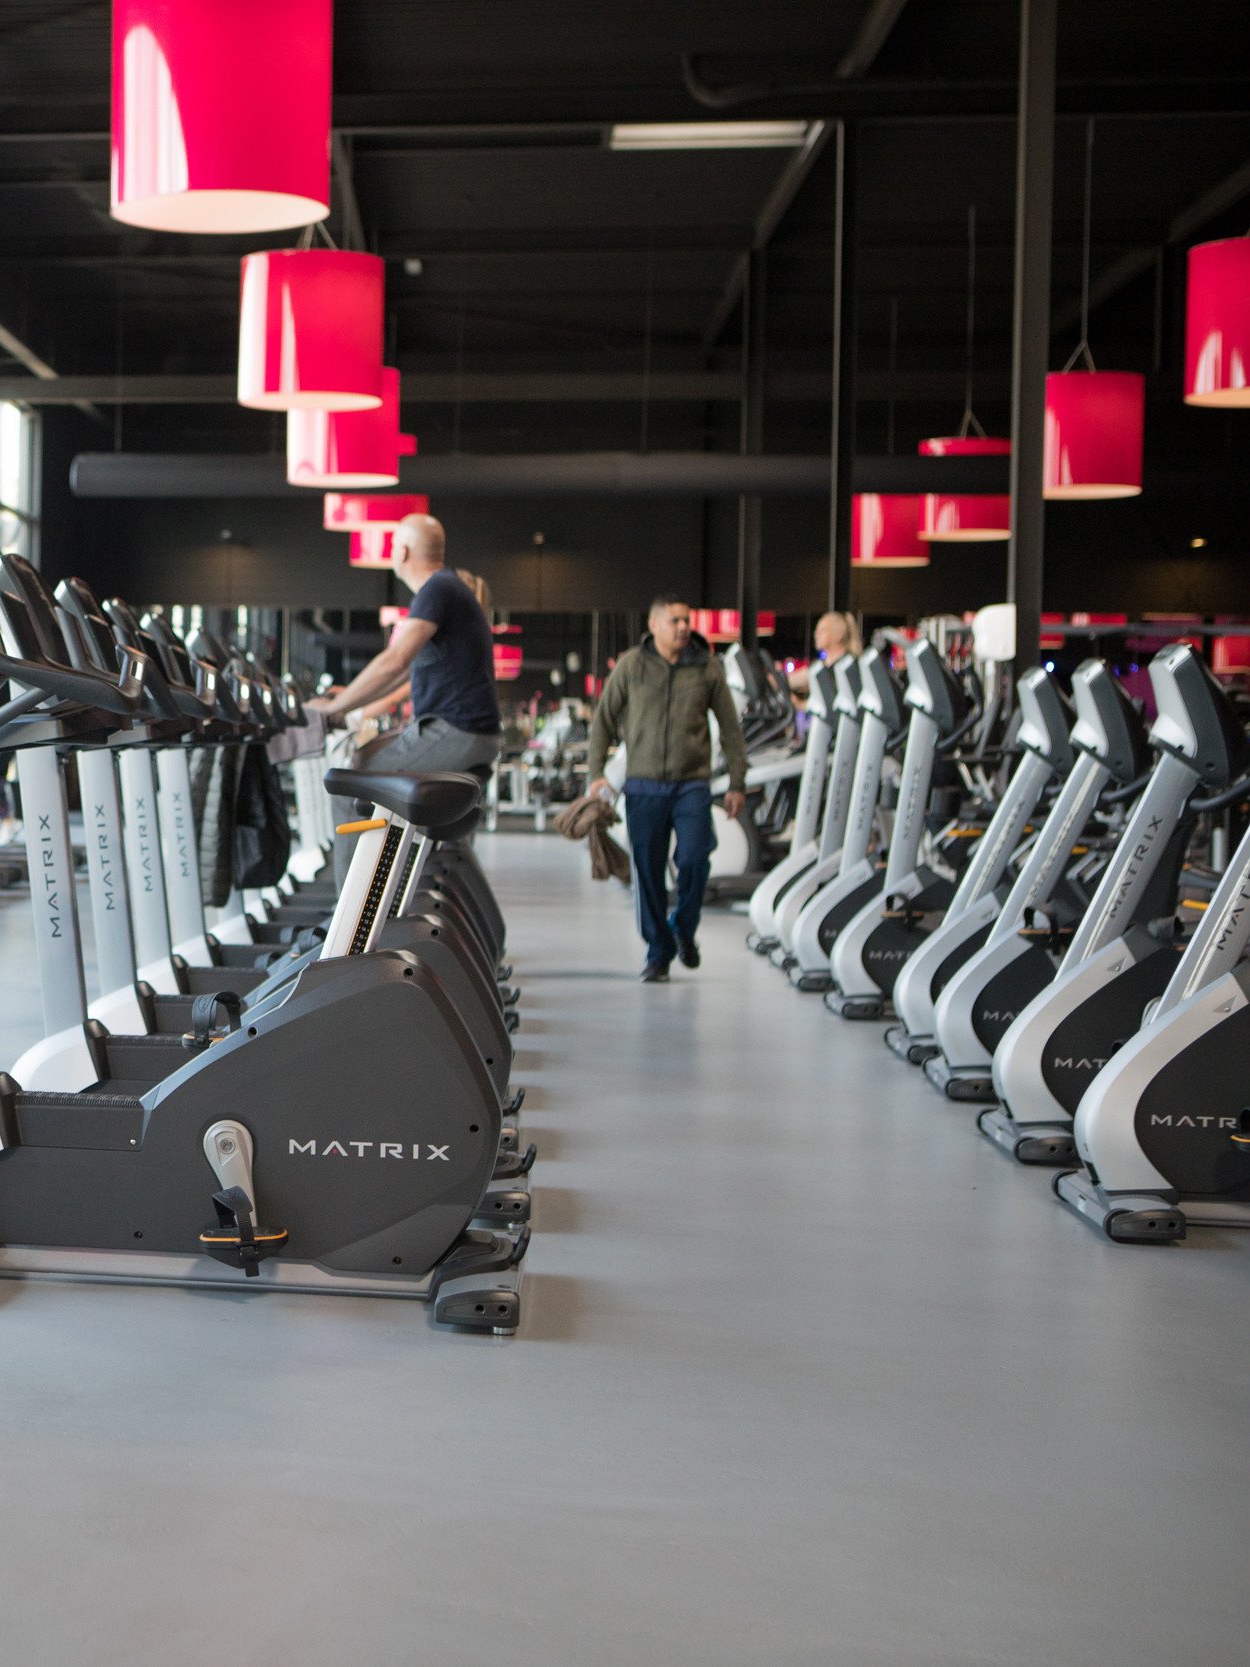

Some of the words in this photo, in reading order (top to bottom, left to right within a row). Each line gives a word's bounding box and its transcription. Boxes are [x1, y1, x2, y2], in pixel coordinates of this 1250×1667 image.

[38, 814, 63, 938] MATRIX
[94, 804, 116, 911] MATRIX
[135, 798, 153, 892] MATRIX
[173, 793, 190, 877] MATRIX
[1110, 814, 1163, 919] MATRIX
[288, 1138, 451, 1161] MATRIX
